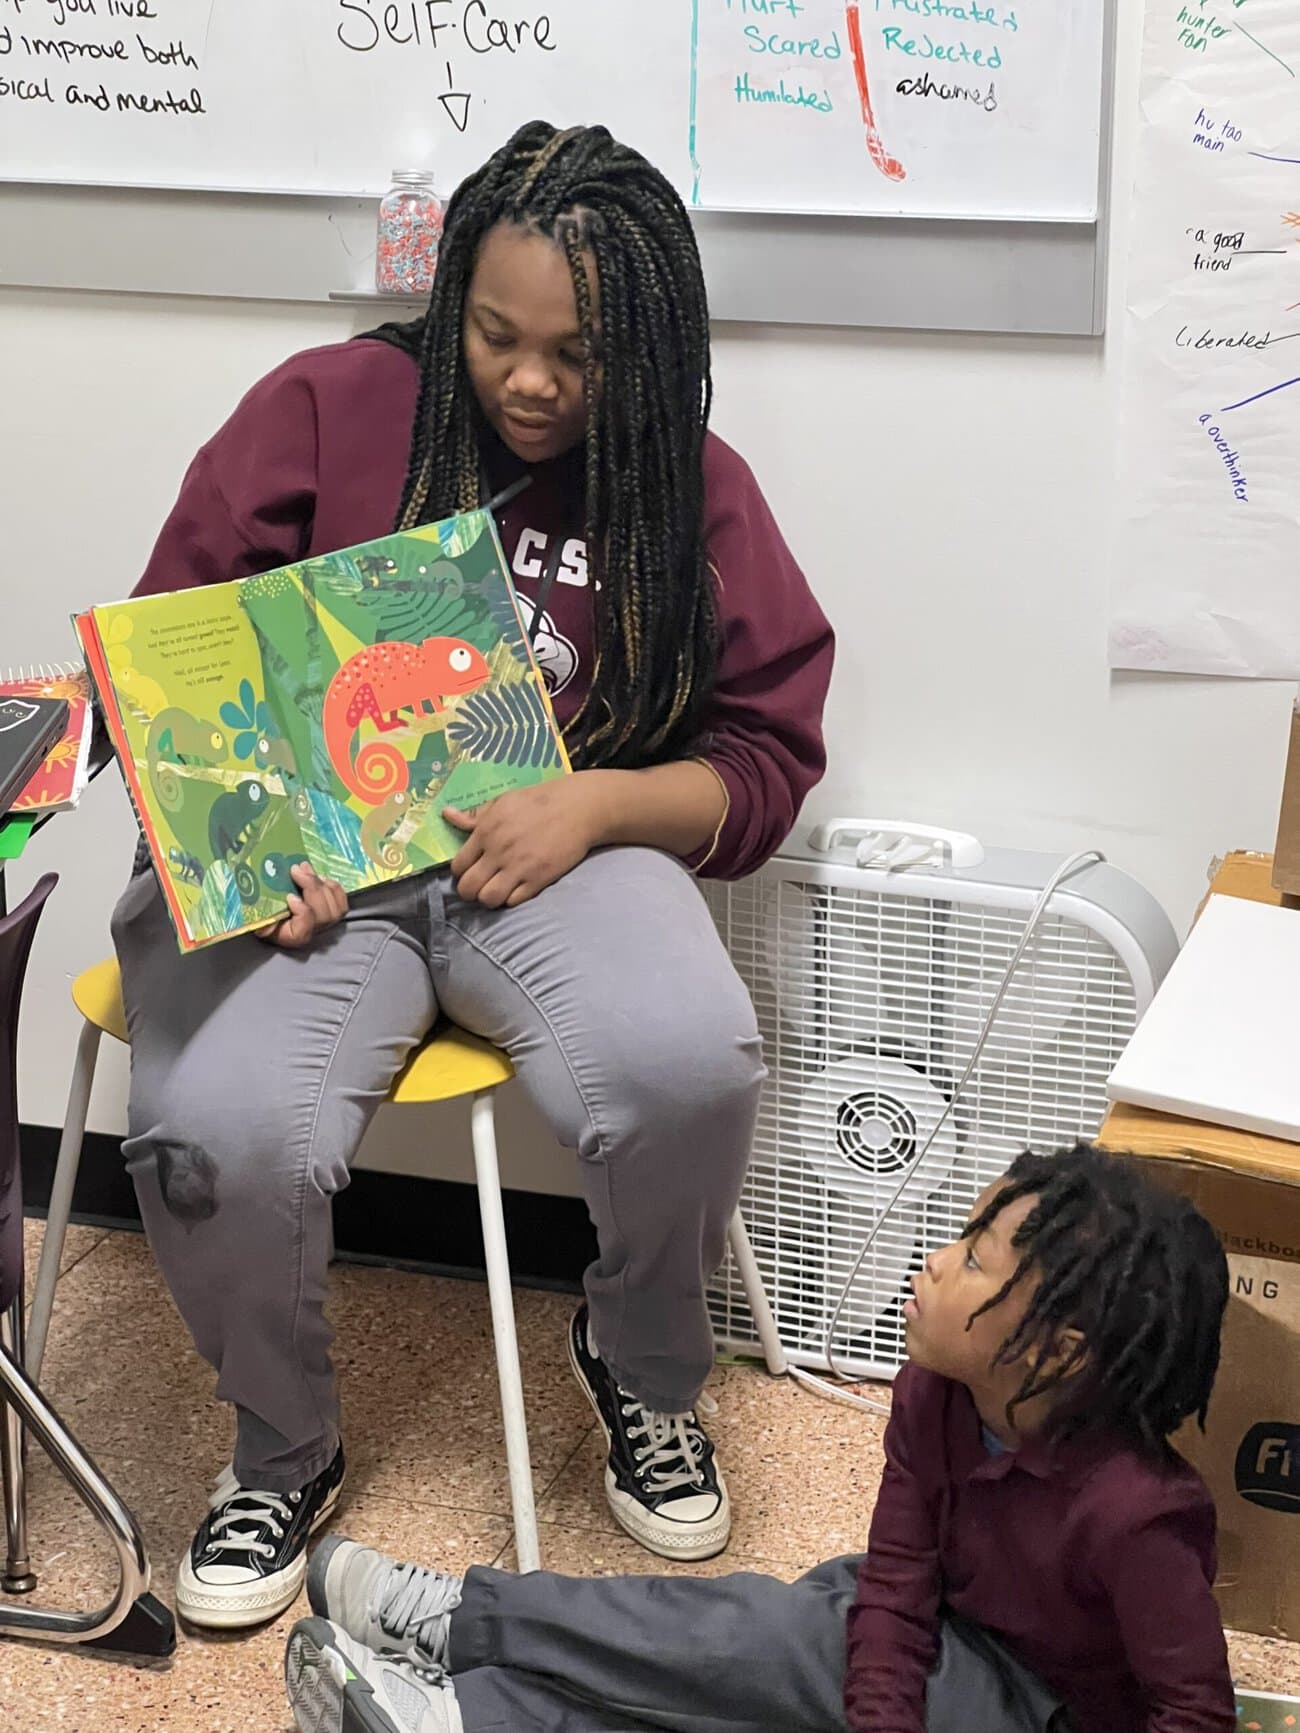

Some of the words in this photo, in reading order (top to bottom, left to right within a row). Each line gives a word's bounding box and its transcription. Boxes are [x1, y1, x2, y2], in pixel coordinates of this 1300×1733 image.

[20, 35, 129, 64] improve
[136, 34, 199, 70] both
[743, 24, 841, 59] Scared
[65, 84, 111, 111] and
[116, 88, 207, 115] mental
[1192, 133, 1225, 153] main
[1221, 119, 1243, 142] tao
[1195, 229, 1207, 244] a
[1193, 253, 1232, 272] friend
[1199, 413, 1213, 426] a
[1207, 426, 1249, 503] overthinker
